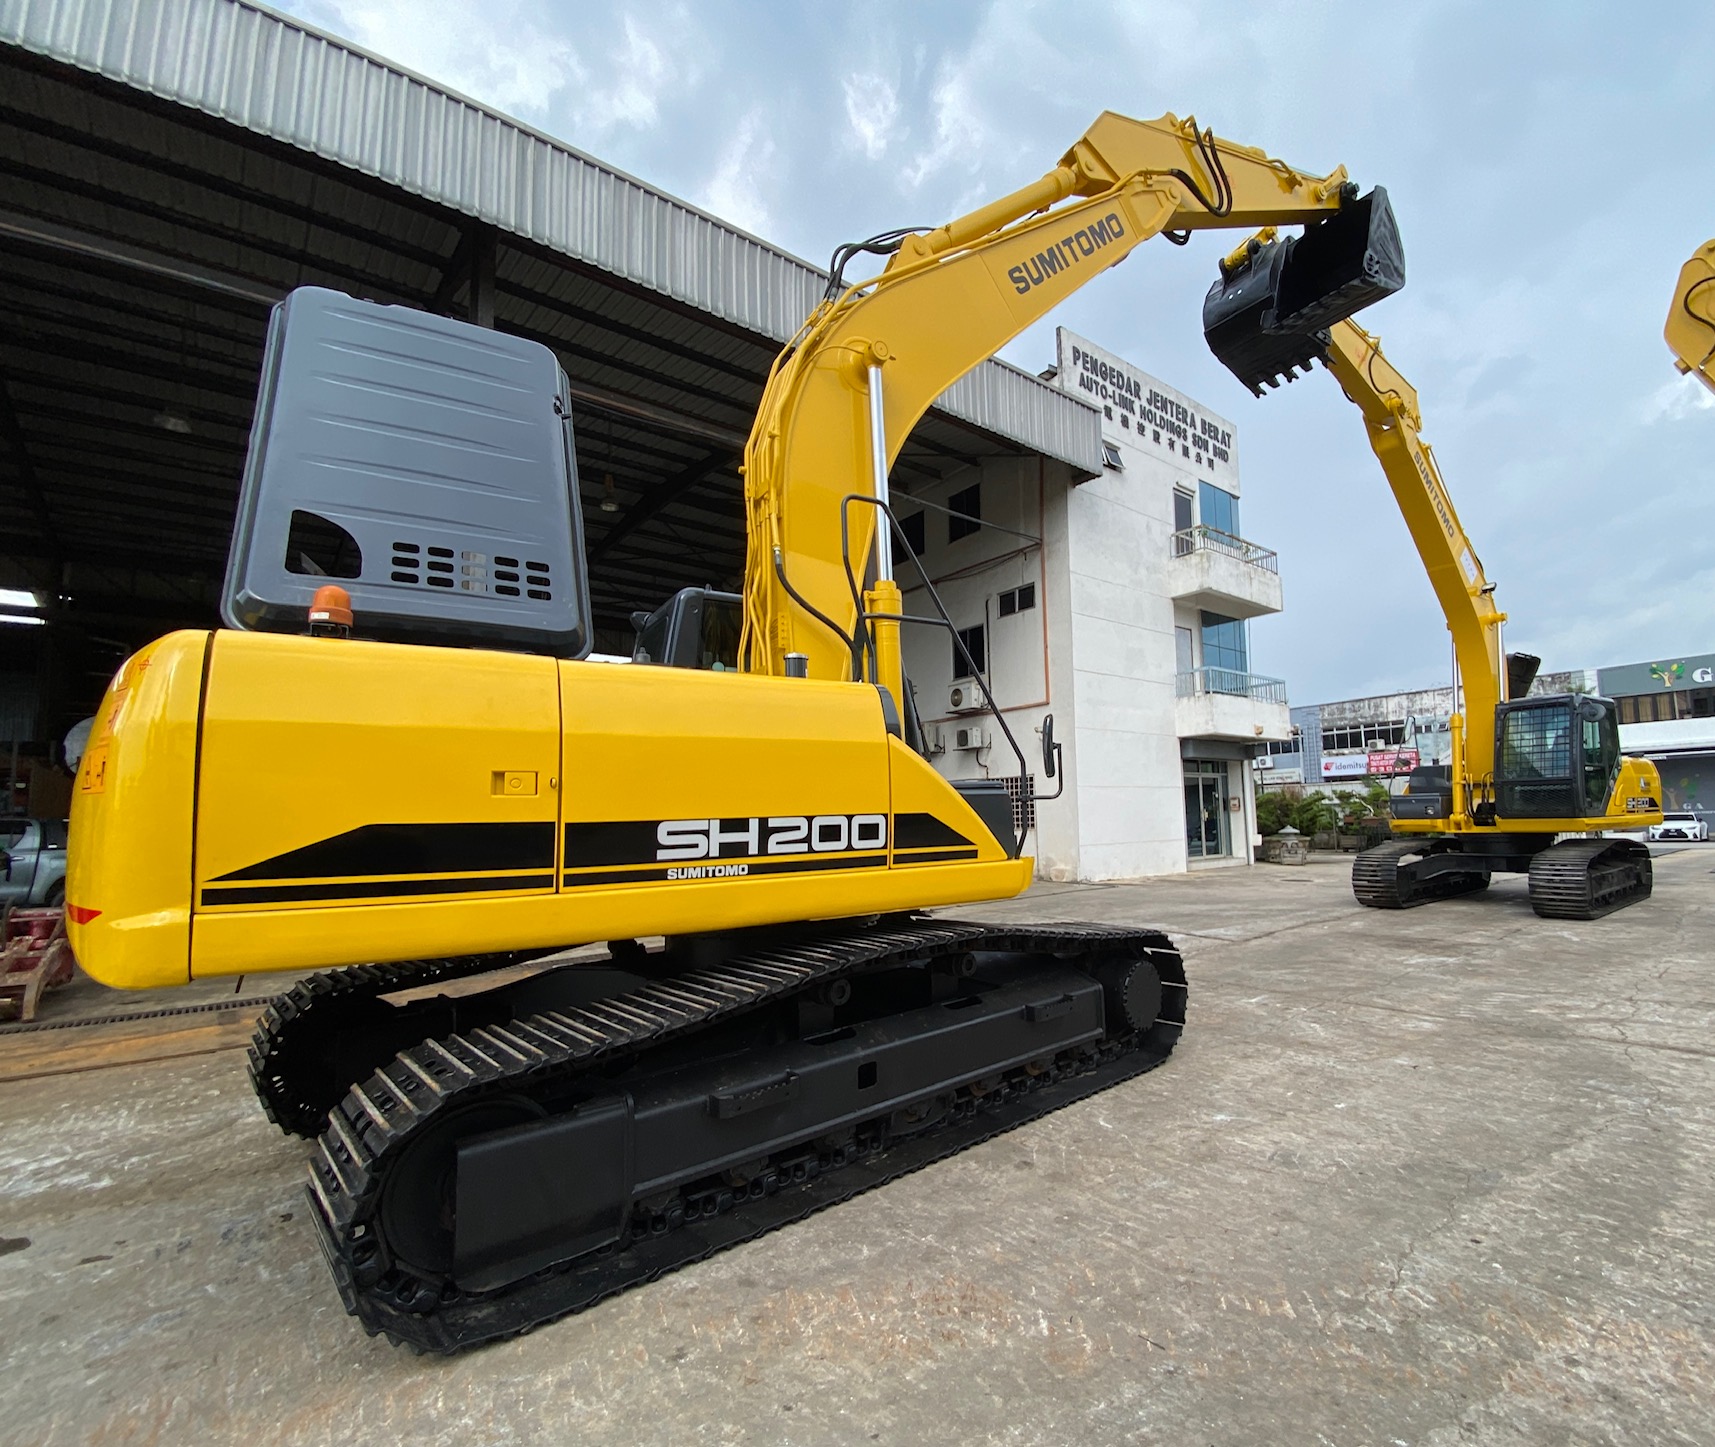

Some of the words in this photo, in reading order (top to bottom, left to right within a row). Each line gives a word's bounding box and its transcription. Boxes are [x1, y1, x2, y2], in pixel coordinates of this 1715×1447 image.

[1007, 213, 1125, 295] SUMITOMO
[1072, 346, 1141, 400] PENGEDAR
[1146, 389, 1197, 431] JENTERA
[1200, 417, 1232, 449] BERAT
[1078, 372, 1135, 415] AUTO-LINK
[1139, 404, 1188, 442] HOLDINGS
[1192, 432, 1209, 454] SDN
[1212, 444, 1229, 463] BHD
[1413, 450, 1455, 538] SUMITOMO
[1335, 762, 1367, 770] idemitsu
[656, 814, 887, 860] SH200
[667, 864, 749, 880] SUMITOMO
